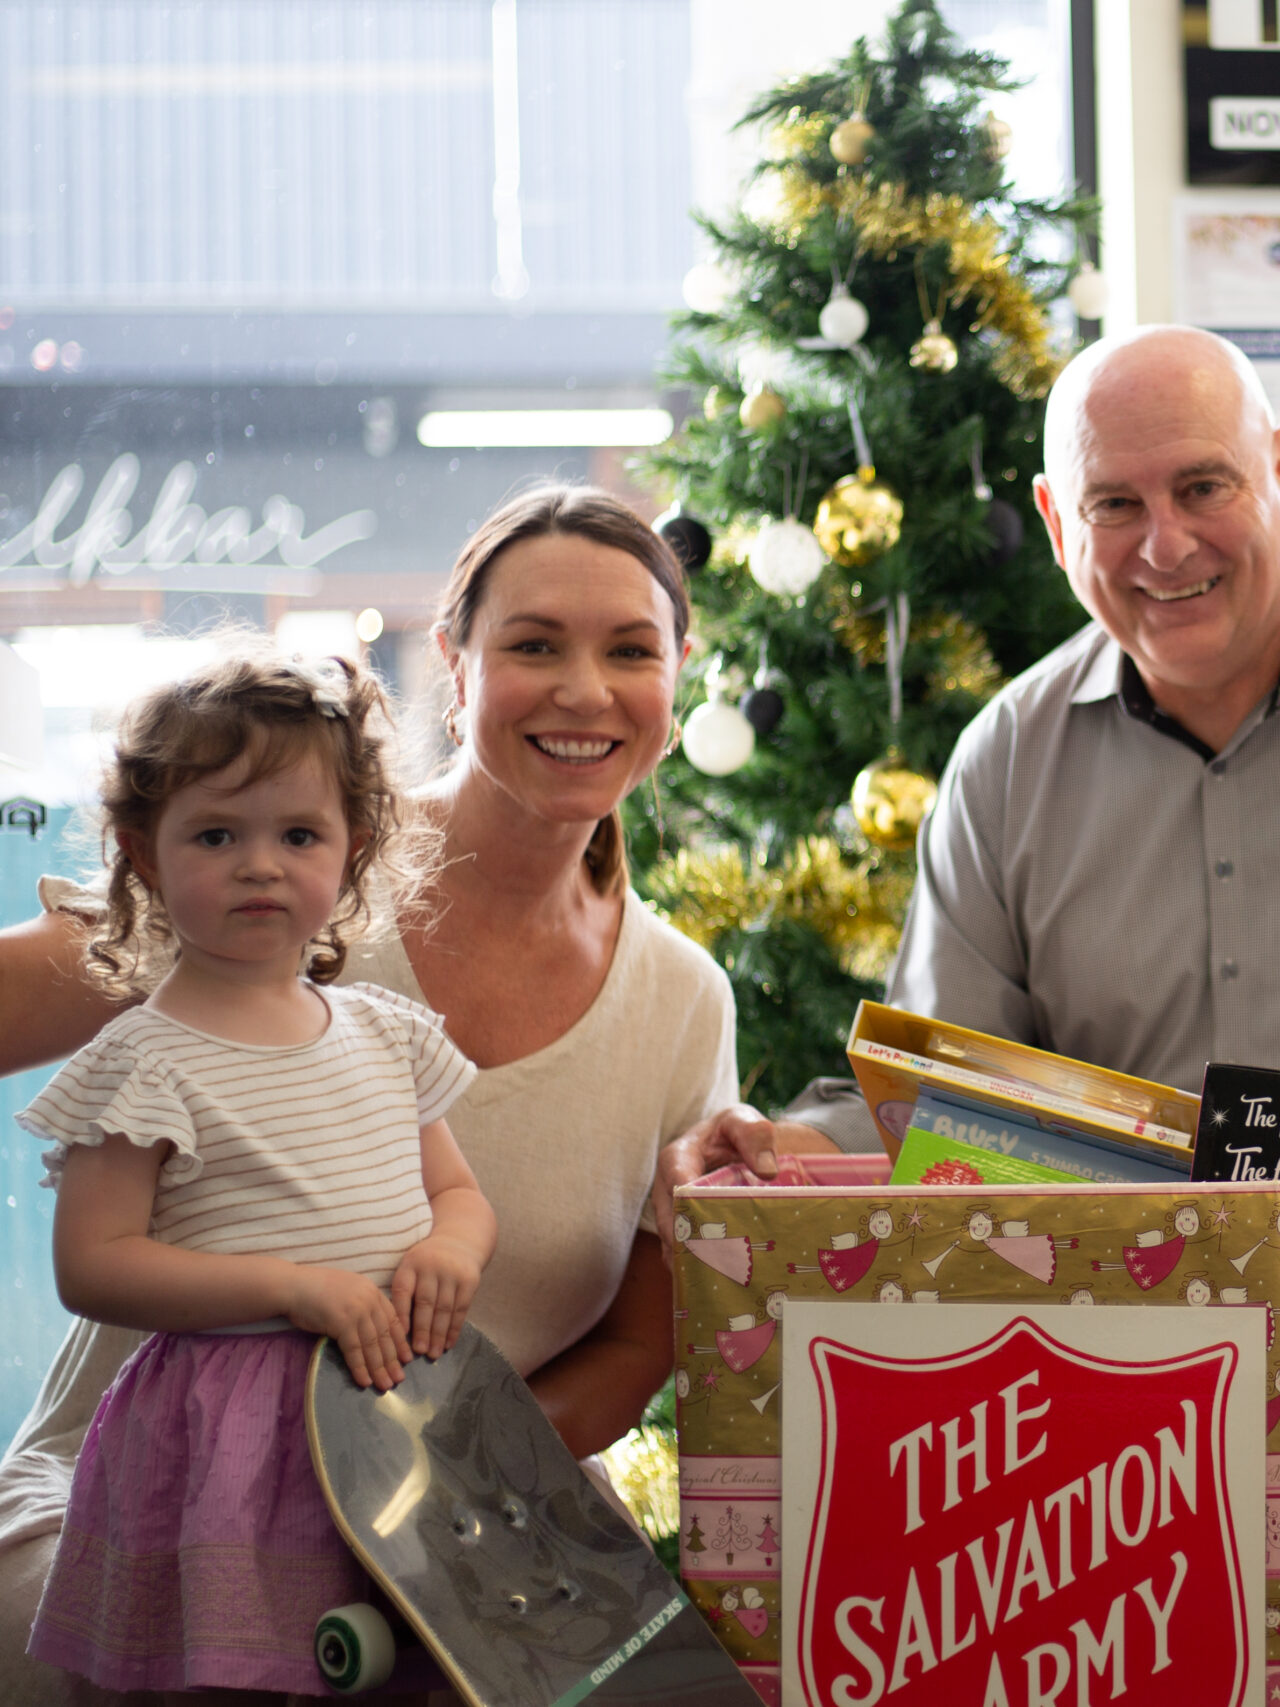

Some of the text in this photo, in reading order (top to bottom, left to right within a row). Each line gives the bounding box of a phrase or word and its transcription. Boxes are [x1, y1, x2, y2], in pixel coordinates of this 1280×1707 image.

[893, 1052, 934, 1071] Pretend
[988, 1081, 1035, 1101] UNICORN
[1240, 1093, 1278, 1127] The
[932, 1115, 1020, 1155] BLUEY
[1040, 1154, 1094, 1180] JUMBO
[1225, 1143, 1270, 1181] The
[680, 1466, 720, 1494] agical
[889, 1369, 1052, 1536] THE
[830, 1399, 1198, 1707] SALVATION
[590, 1597, 683, 1684] SKATE OF MIND
